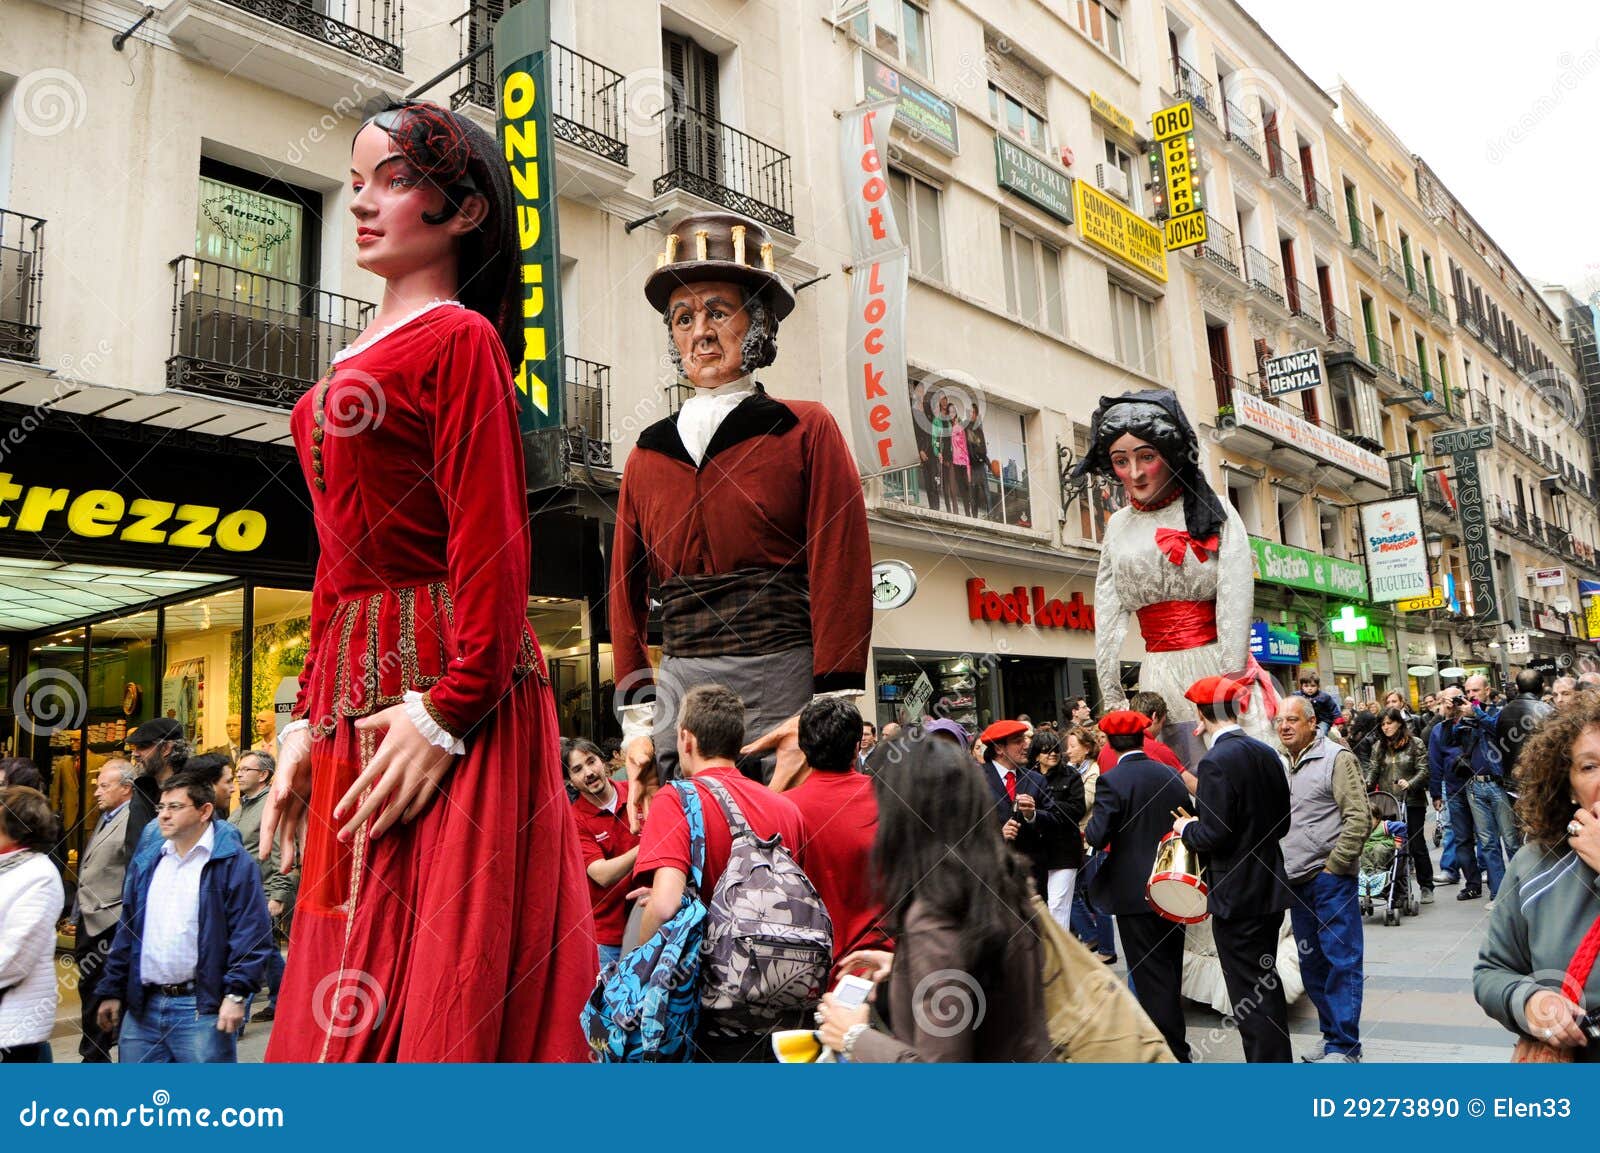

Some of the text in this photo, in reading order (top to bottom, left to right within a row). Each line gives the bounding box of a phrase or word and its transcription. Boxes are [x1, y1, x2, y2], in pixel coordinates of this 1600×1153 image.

[1155, 107, 1190, 136] ORO
[1004, 143, 1069, 197] PELETERIA
[1168, 137, 1190, 214] COMPRO
[221, 204, 275, 226] Atrezzo
[1083, 190, 1123, 229] COMPRO
[1169, 215, 1204, 246] JOYAS
[1268, 352, 1318, 377] CLINICA
[1271, 370, 1320, 393] DENTAL
[1433, 429, 1492, 454] SHOES
[1375, 571, 1425, 593] JUGUETES
[967, 577, 1095, 632] Foot Lock
[1409, 597, 1443, 610] ORO
